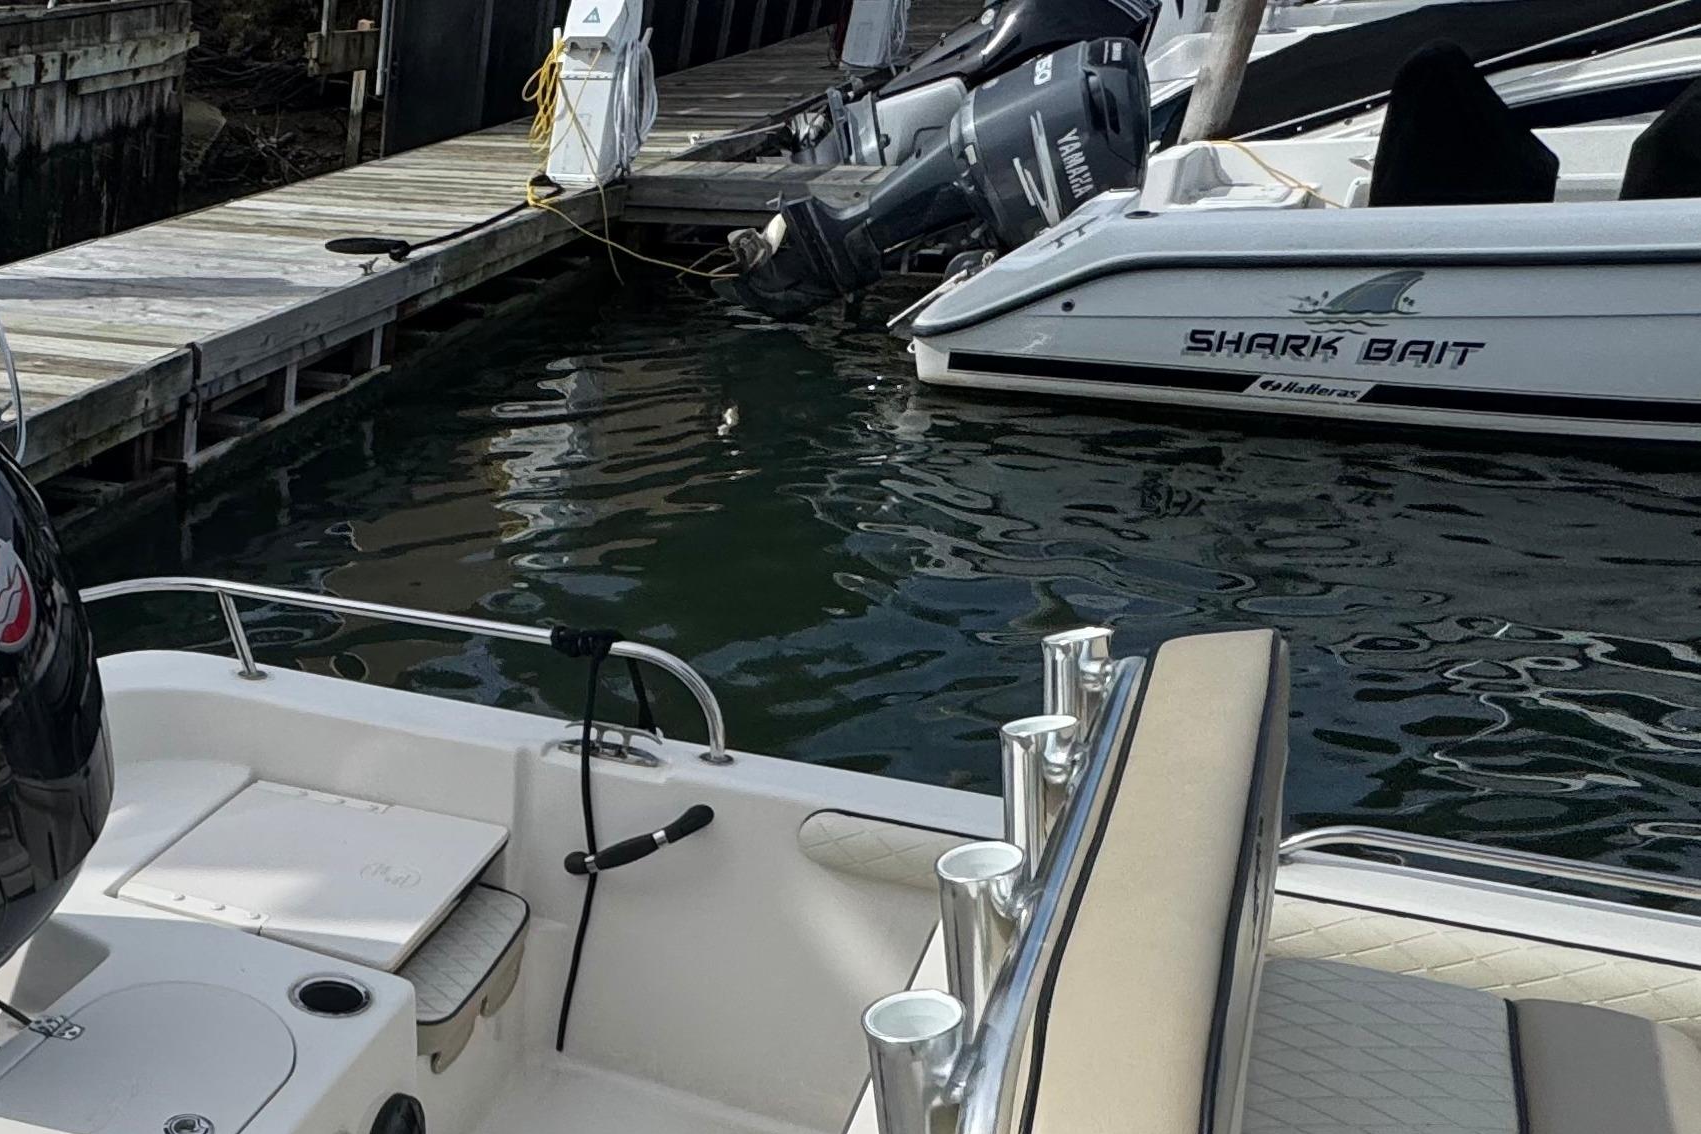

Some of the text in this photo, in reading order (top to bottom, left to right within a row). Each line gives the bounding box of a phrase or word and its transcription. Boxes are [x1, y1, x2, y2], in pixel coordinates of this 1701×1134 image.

[1056, 127, 1095, 199] YAMAHA
[1186, 328, 1487, 367] SHARK BAIT
[1281, 381, 1361, 400] Hatteras
